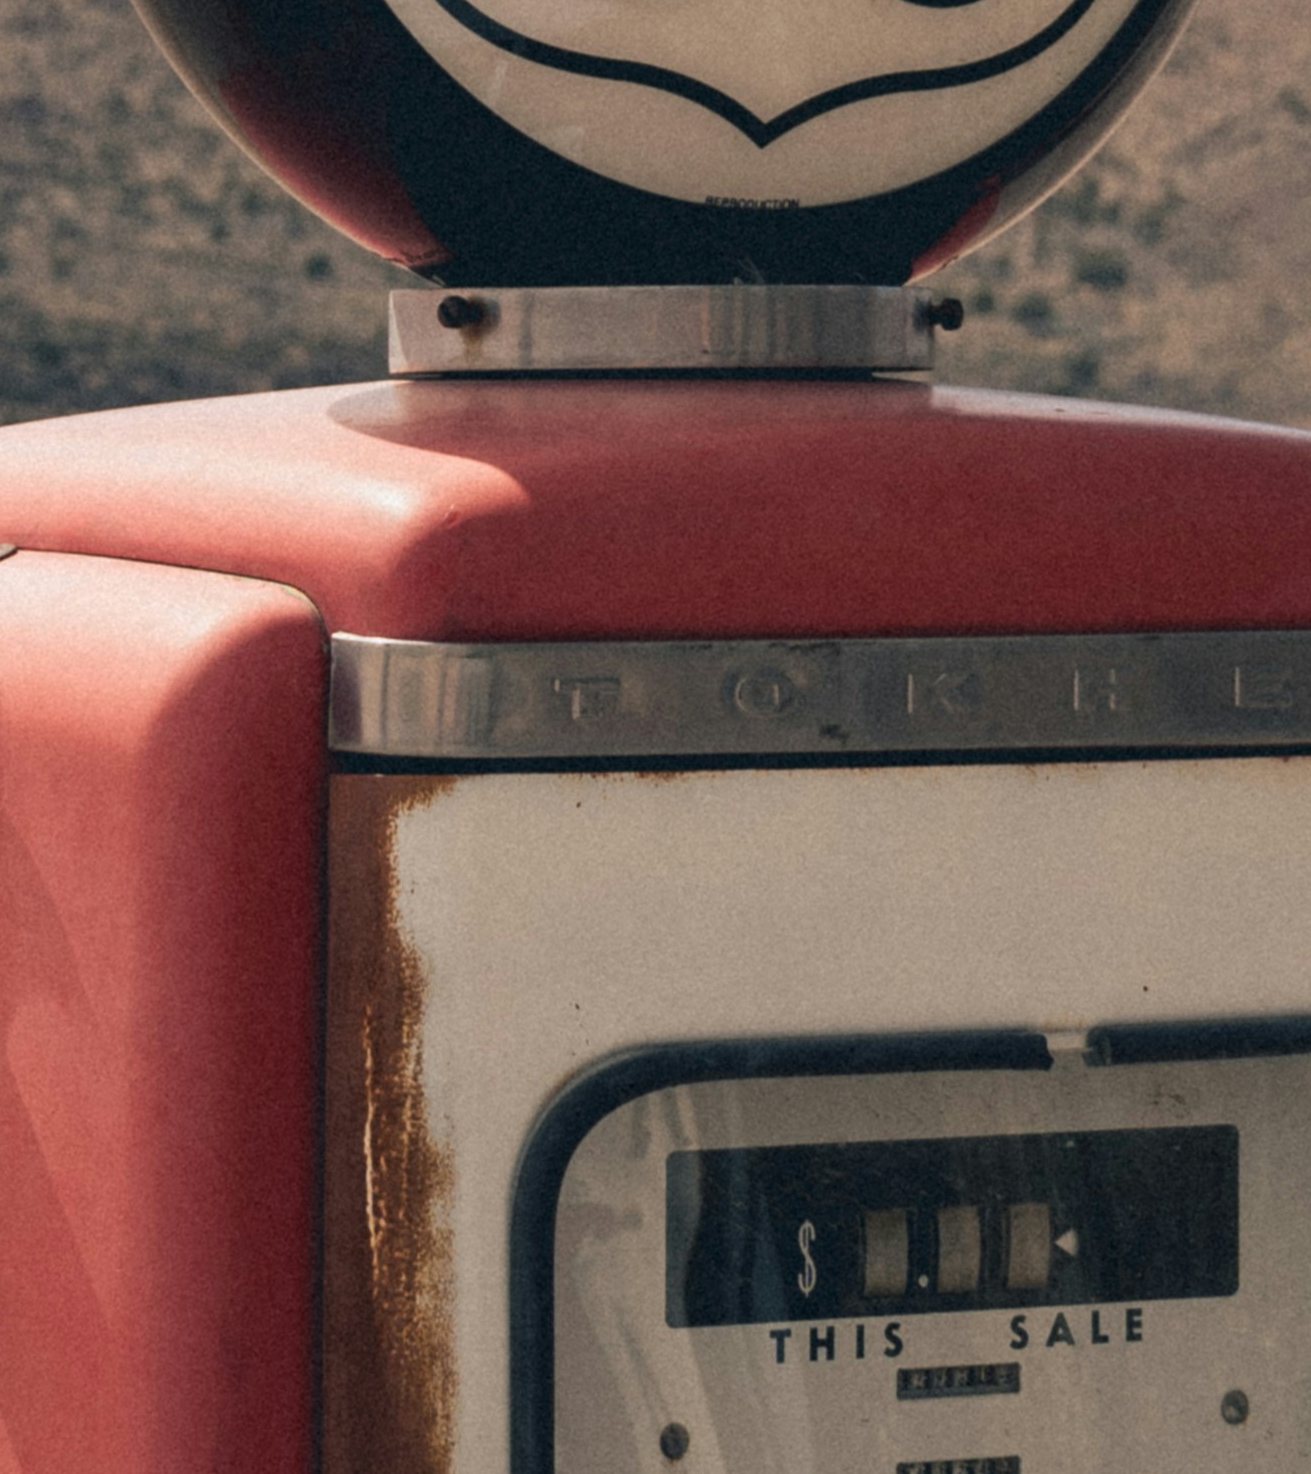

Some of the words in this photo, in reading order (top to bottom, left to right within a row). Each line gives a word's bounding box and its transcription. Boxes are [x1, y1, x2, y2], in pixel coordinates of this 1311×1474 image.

[705, 195, 800, 210] REPRODUCTION
[769, 1322, 904, 1364] THIS
[1009, 1307, 1144, 1350] SALE
